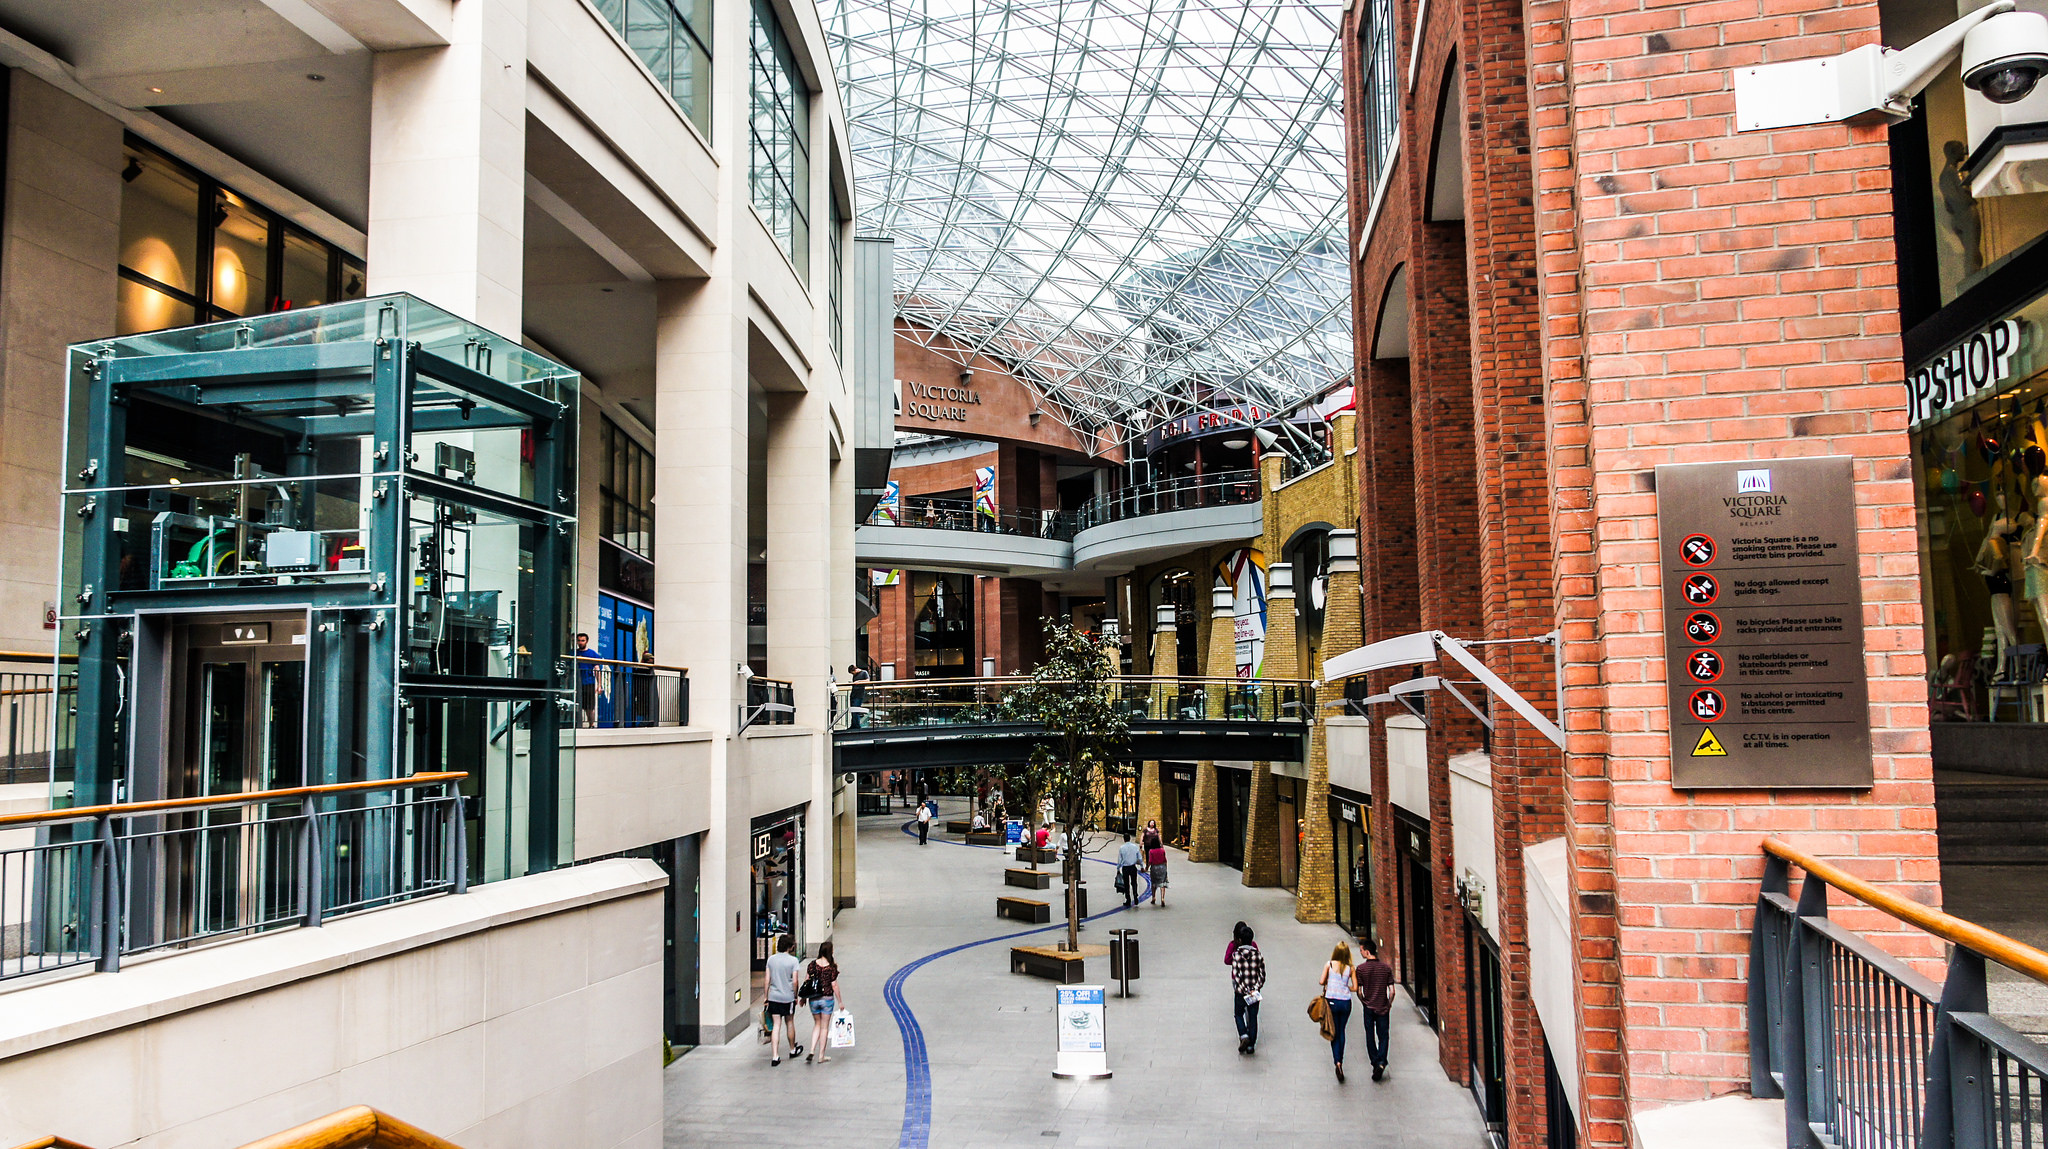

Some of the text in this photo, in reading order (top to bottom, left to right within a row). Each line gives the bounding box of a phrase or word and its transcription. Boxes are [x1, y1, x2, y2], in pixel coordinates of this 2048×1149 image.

[909, 381, 981, 405] VICTORIA
[908, 401, 967, 422] SQUARE
[1722, 495, 1788, 507] VICTORIA
[1730, 506, 1782, 519] SQUARE
[1731, 537, 1762, 545] Victoria
[1763, 536, 1791, 545] Square
[1732, 544, 1766, 553] smoking
[1767, 543, 1794, 551] centre.
[1796, 542, 1821, 550] Please
[1732, 550, 1825, 561] cigarette bins provided.
[1747, 579, 1767, 588] dogs
[1768, 578, 1800, 586] allowed
[1802, 578, 1829, 586] except
[1734, 587, 1780, 596] guide dogs.
[1749, 618, 1780, 627] bicycles
[1781, 617, 1807, 625] Please
[1808, 617, 1822, 625] use
[1824, 616, 1842, 624] bike
[1736, 626, 1757, 634] racks
[1758, 625, 1793, 634] provided
[1751, 652, 1799, 660] rollerblades
[1738, 659, 1828, 668] skateboards permitted
[1754, 691, 1783, 699] alcohol
[1794, 690, 1843, 699] intoxicating
[1741, 699, 1826, 707] substances permitted
[1743, 733, 1771, 741] C.C.T.V.
[1791, 732, 1830, 741] operation
